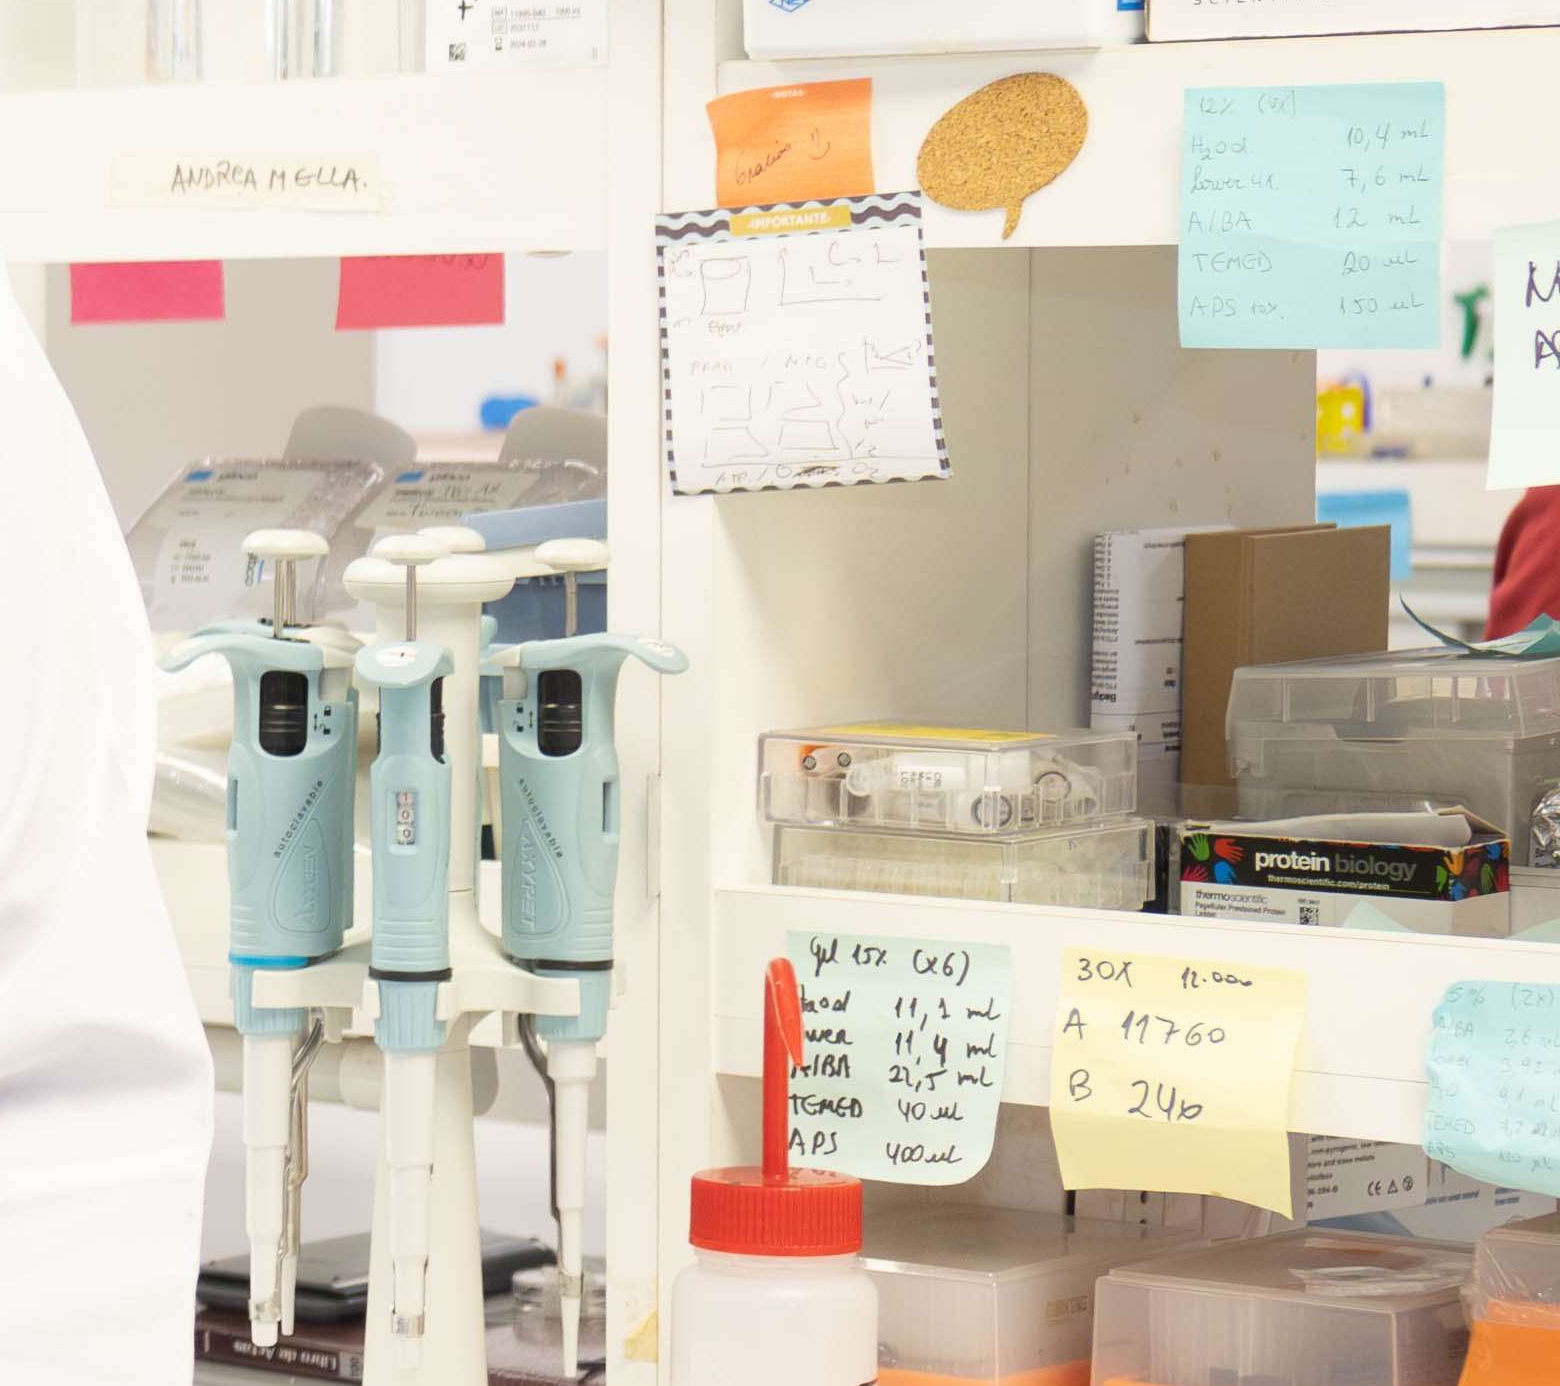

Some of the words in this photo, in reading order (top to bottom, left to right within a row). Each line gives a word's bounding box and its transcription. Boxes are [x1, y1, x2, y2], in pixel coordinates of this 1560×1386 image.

[273, 780, 324, 859] autoclavable
[519, 777, 564, 859] autoclavable
[1255, 850, 1330, 872] protein
[1334, 853, 1417, 882] biology
[1267, 874, 1390, 891] thermoscientific.com/protein
[1062, 1008, 1088, 1040] A
[1121, 1010, 1226, 1047] 11760
[1069, 1068, 1093, 1102] B
